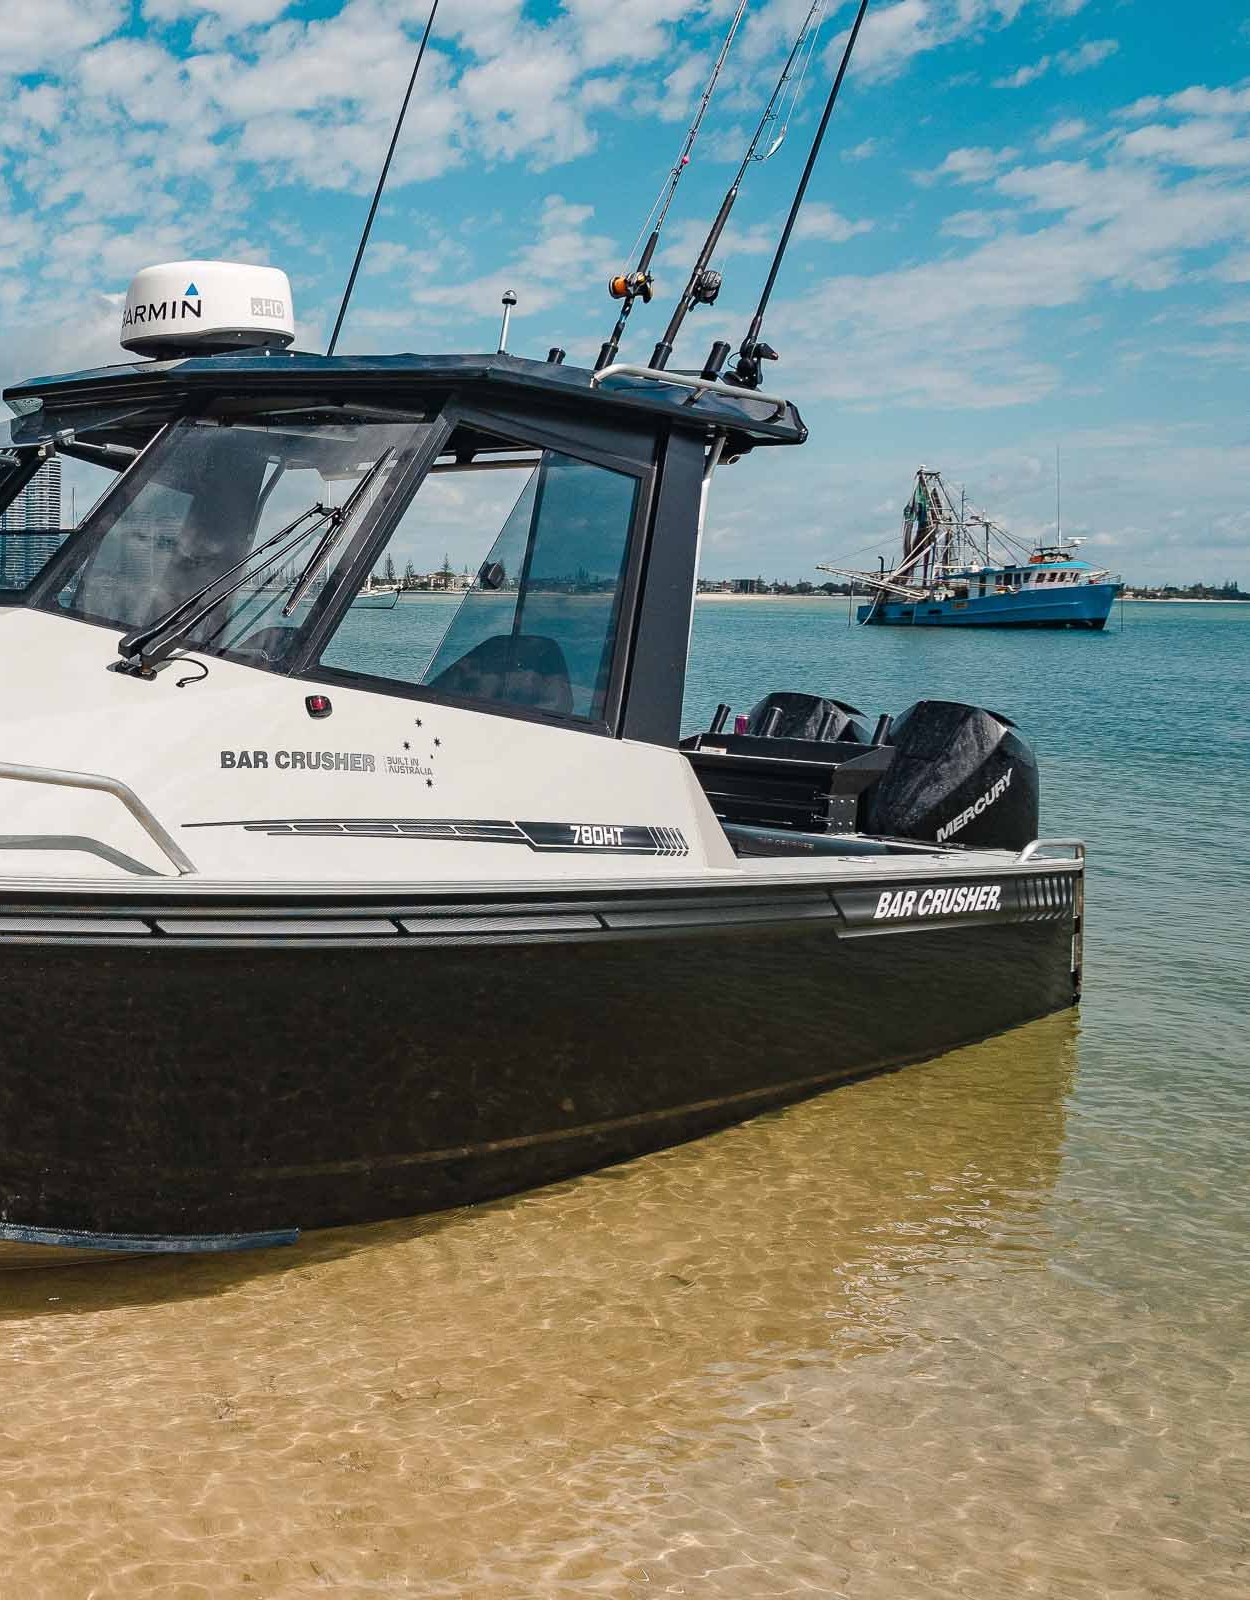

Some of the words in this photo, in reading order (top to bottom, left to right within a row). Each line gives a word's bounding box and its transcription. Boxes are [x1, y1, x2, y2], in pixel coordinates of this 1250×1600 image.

[220, 750, 269, 769] BAR
[274, 750, 376, 773] CRUSHER
[386, 756, 409, 766] BUILT
[410, 757, 420, 767] IN
[388, 765, 433, 776] AUSTRALIA
[936, 767, 1013, 843] MERCURY
[570, 824, 624, 846] 780HT
[873, 891, 917, 919] BAR
